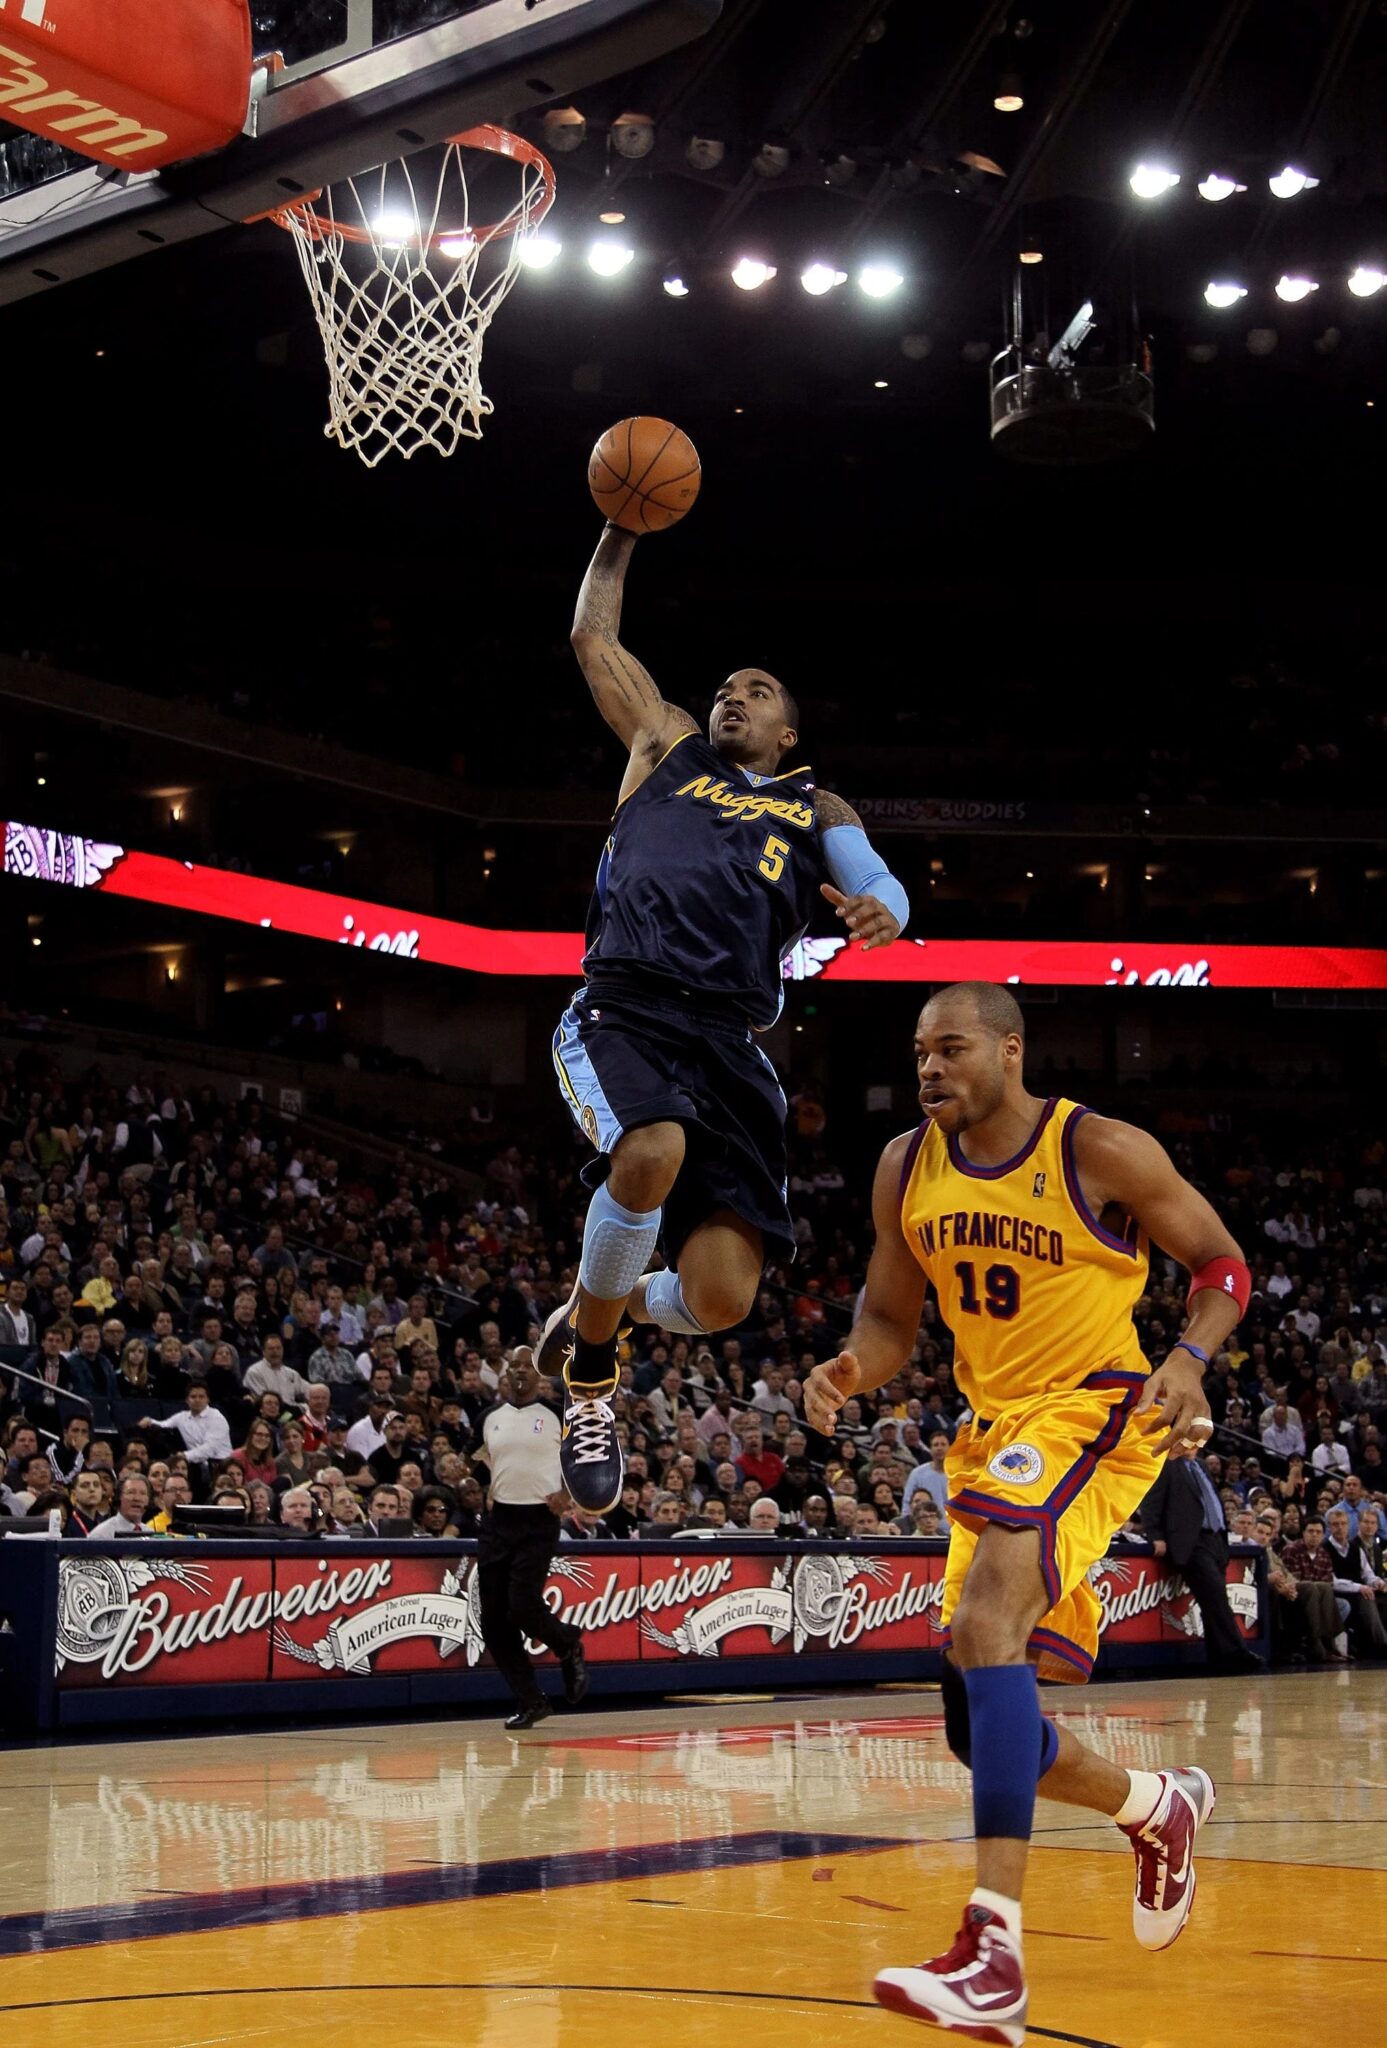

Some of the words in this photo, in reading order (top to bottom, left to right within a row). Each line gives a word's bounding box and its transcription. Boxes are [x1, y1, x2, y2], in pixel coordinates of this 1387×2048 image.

[0, 45, 168, 156] arm
[671, 775, 815, 829] Nuggets
[854, 799, 920, 817] DRINS
[940, 801, 1027, 820] BUDDIES
[757, 832, 791, 883] 5
[939, 1211, 1063, 1266] FRANCISCO
[954, 1261, 1020, 1321] 19
[86, 1559, 391, 1679] Budweiser
[699, 1604, 752, 1642] American
[756, 1599, 788, 1620] Lager
[820, 1571, 946, 1649] Budwe
[1234, 1592, 1256, 1610] Lager
[346, 1612, 416, 1656] American
[421, 1606, 462, 1631] Lager
